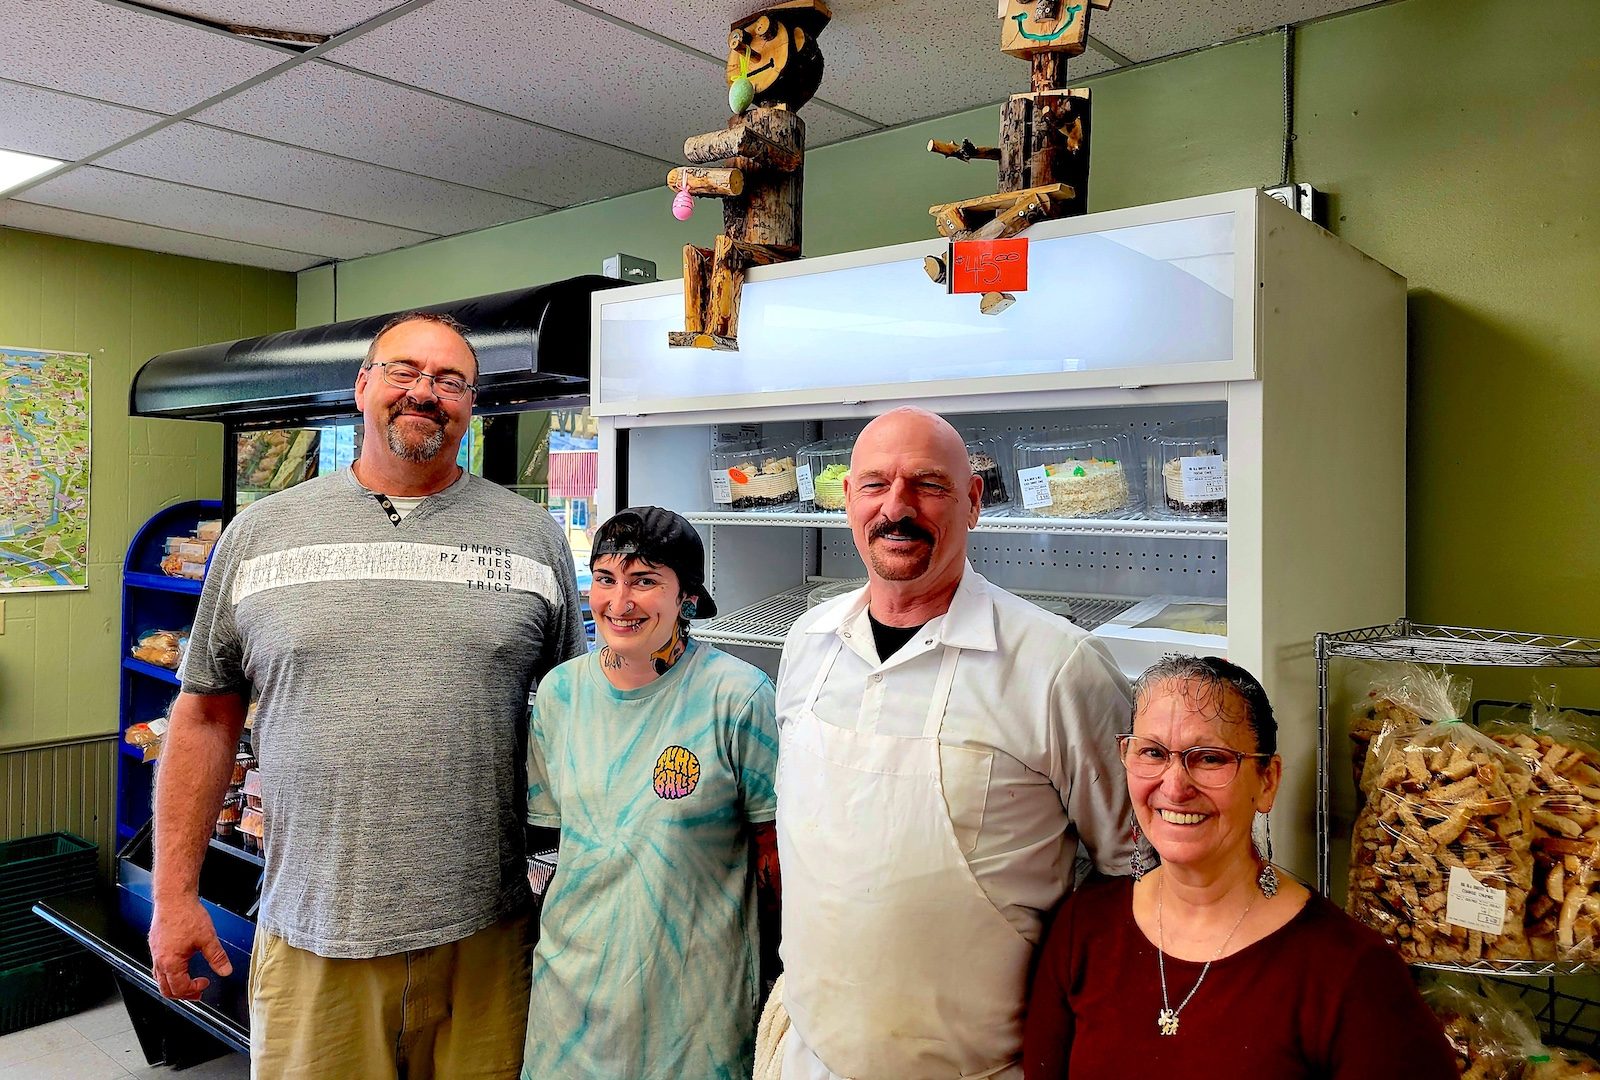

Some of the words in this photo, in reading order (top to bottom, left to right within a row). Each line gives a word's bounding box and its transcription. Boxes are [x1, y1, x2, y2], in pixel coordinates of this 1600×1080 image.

[460, 543, 511, 558] DNMSE
[440, 552, 458, 564] PZ
[487, 569, 511, 581] DIS
[466, 579, 512, 593] TRICT
